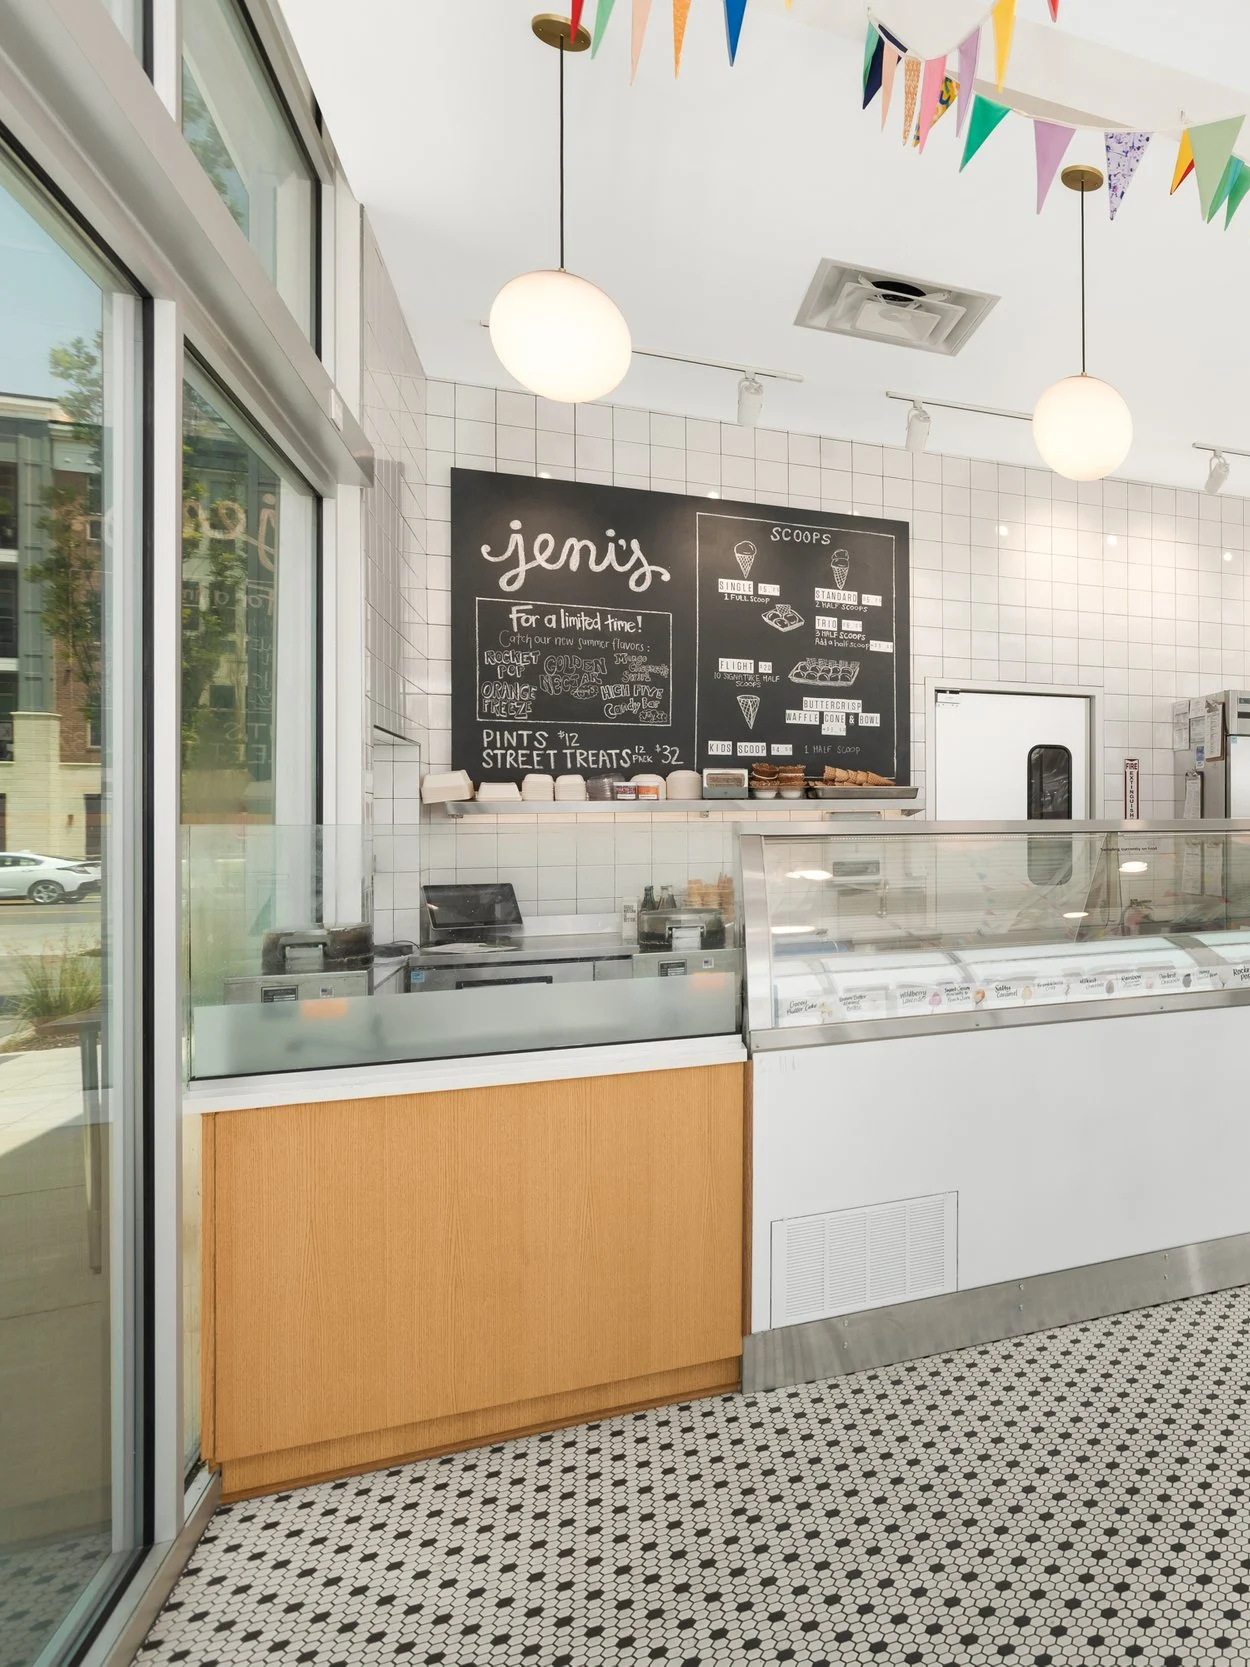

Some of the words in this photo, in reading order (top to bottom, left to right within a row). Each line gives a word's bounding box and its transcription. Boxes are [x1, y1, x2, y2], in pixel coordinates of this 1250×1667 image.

[770, 527, 832, 545] SCOOPS
[480, 519, 671, 592] jeni's
[719, 581, 753, 593] SINGLE
[815, 589, 857, 603] STANDARD
[509, 604, 540, 632] For
[544, 615, 556, 628] a
[560, 608, 601, 632] limited
[604, 614, 642, 633] time!
[816, 618, 837, 629] TRIO
[499, 630, 533, 648] Catch
[534, 634, 551, 644] our
[554, 637, 574, 646] new
[578, 637, 609, 650] summer
[484, 649, 541, 666] ROCKET
[544, 654, 608, 676] GOLDEN
[720, 660, 753, 671] FLIGHT
[497, 664, 526, 680] POP
[481, 681, 538, 701] ORANGE
[539, 672, 603, 696] NECTAR
[600, 684, 630, 700] HIGH
[633, 684, 664, 700] FIVE
[482, 699, 533, 720] FREEZE
[604, 698, 641, 720] Candy
[803, 699, 862, 712] BUTTERCRISP
[786, 712, 819, 724] WAFFLE
[824, 714, 845, 724] CONE
[848, 715, 855, 724] &
[860, 714, 880, 725] BOWL
[482, 729, 549, 748] PINTS
[557, 730, 580, 748] $12
[709, 742, 732, 753] KIDS
[738, 744, 766, 754] SCOOP
[482, 749, 558, 770] STREET
[562, 749, 633, 768] TREATS
[634, 745, 647, 754] 12
[656, 744, 685, 765] $32
[1125, 762, 1138, 770] FIRE
